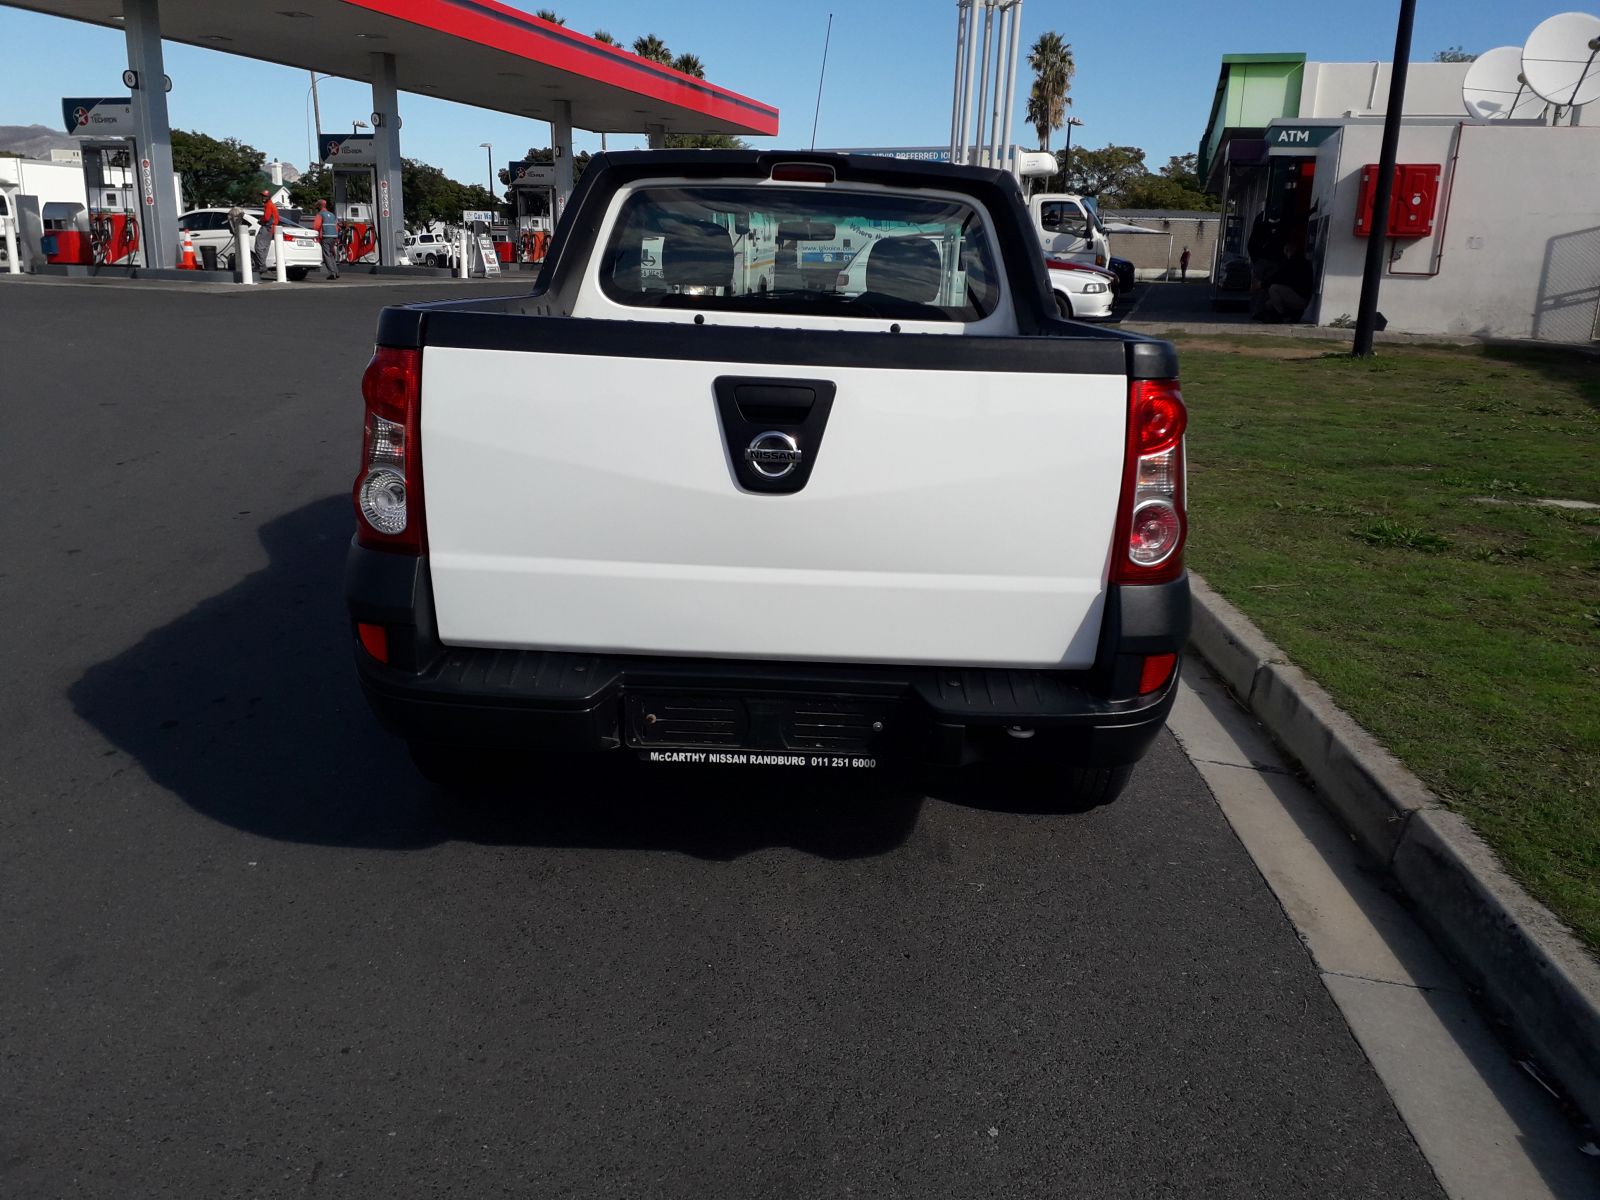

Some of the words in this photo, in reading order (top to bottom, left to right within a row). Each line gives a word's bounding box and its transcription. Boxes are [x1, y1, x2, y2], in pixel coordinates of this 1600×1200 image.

[127, 73, 133, 83] 8
[1278, 130, 1310, 142] ATM
[750, 450, 796, 460] NISSAN
[650, 751, 706, 763] McCARTHY
[709, 752, 747, 764] NISSAN
[749, 754, 806, 766] RANDBURG
[811, 756, 829, 767] 011
[832, 757, 849, 767] 251
[852, 758, 876, 768] 6000
